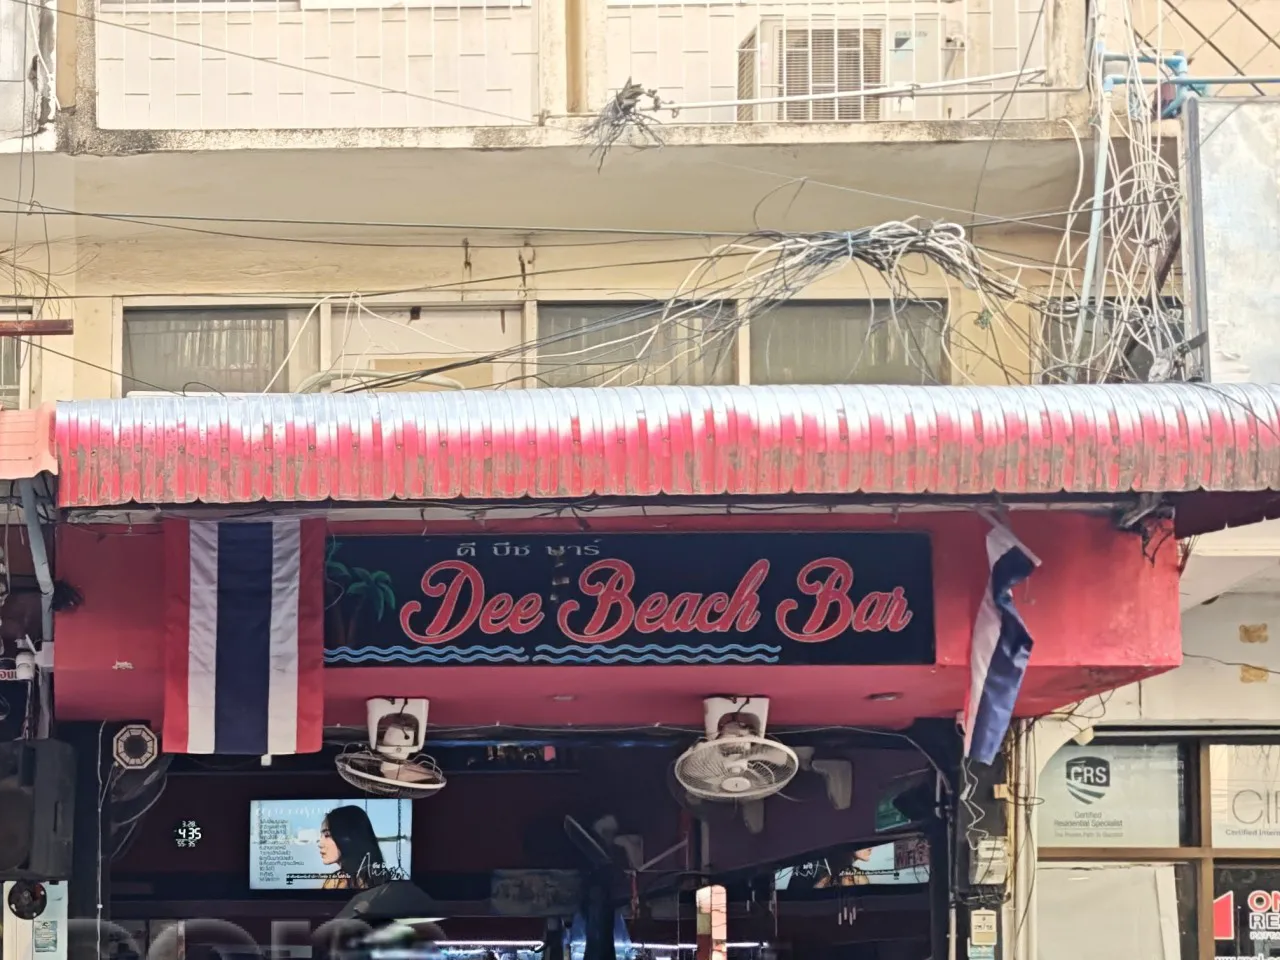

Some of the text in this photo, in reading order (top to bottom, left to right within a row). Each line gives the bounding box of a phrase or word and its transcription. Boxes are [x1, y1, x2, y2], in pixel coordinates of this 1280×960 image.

[399, 557, 913, 644] Dee Beach Bar
[1070, 766, 1108, 784] CRS
[1074, 811, 1102, 819] Certified
[1231, 788, 1280, 825] CI
